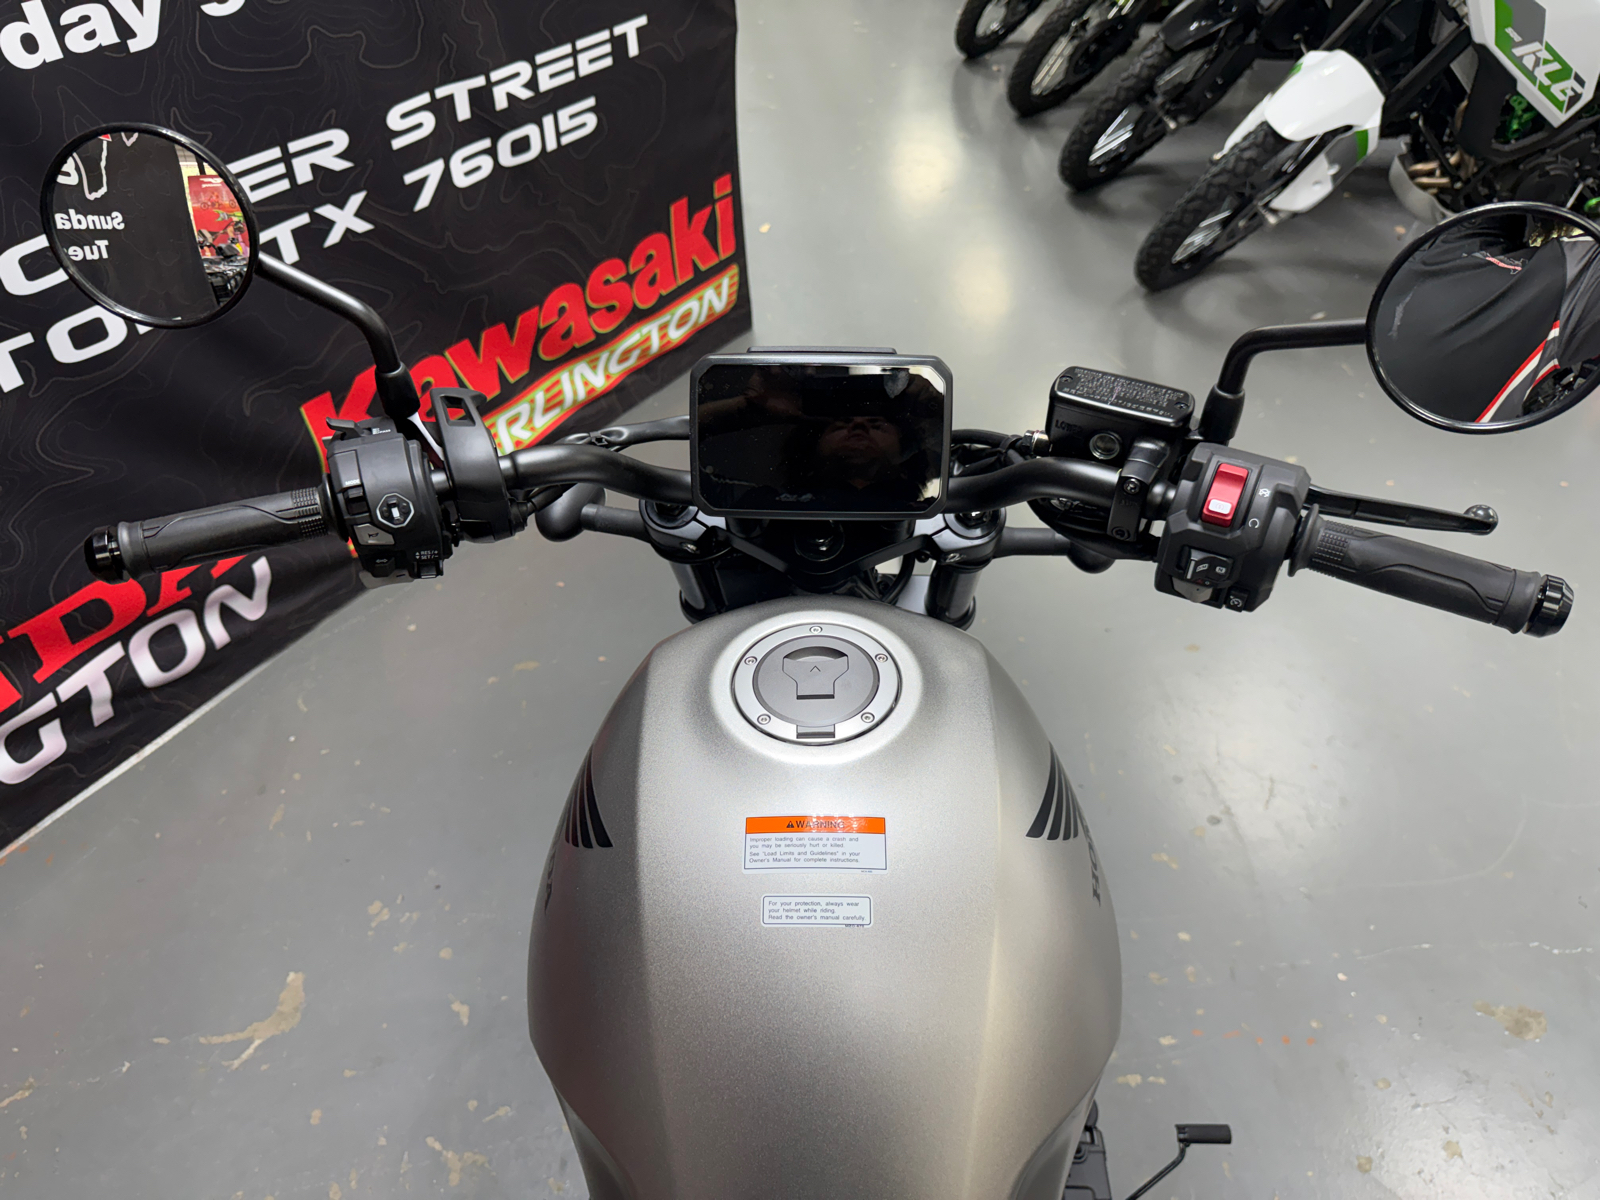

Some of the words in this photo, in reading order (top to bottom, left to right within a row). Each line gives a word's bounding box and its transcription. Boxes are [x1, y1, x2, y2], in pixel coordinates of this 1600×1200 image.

[386, 14, 649, 151] STREET
[259, 189, 376, 265] TX
[402, 95, 598, 213] 76015
[301, 173, 737, 474] Kawasaki
[498, 276, 730, 456] RLINGTON
[345, 478, 361, 486] MODE
[796, 820, 845, 829] WARNING
